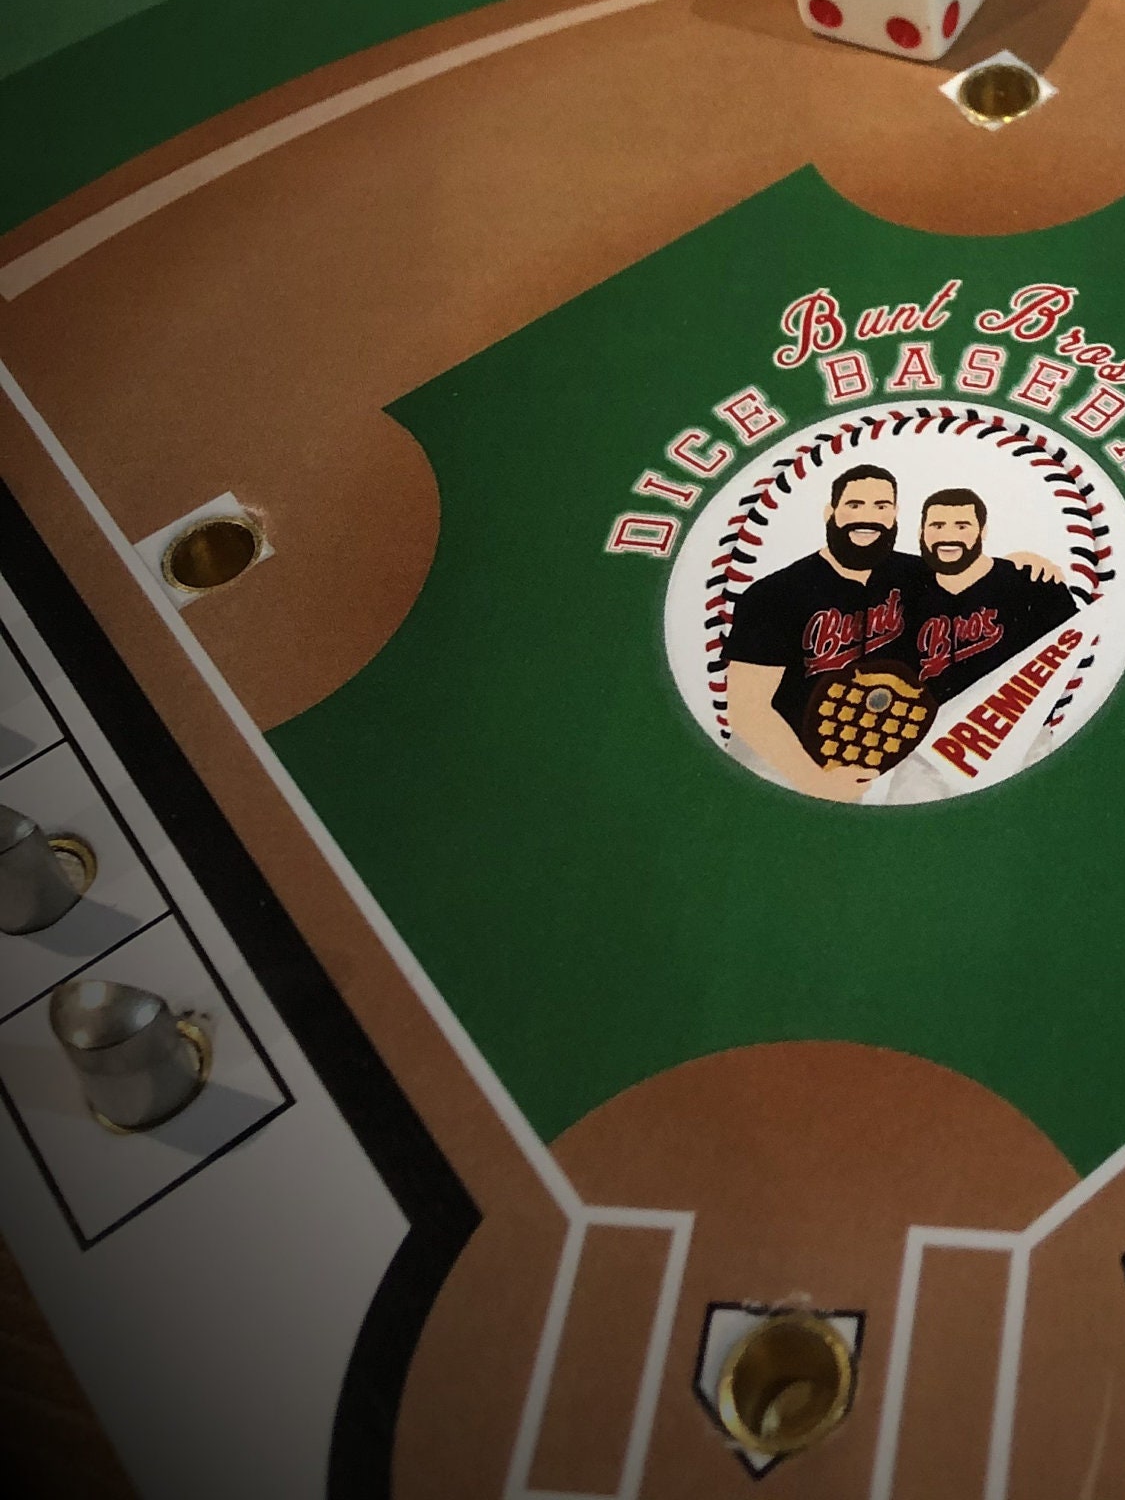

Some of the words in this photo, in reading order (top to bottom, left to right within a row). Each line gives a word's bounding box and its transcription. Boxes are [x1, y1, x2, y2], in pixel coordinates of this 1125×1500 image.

[773, 278, 964, 370] Bunt
[605, 384, 788, 560] DICE
[802, 588, 904, 668] Bunt
[931, 627, 1085, 779] PREMIERS
